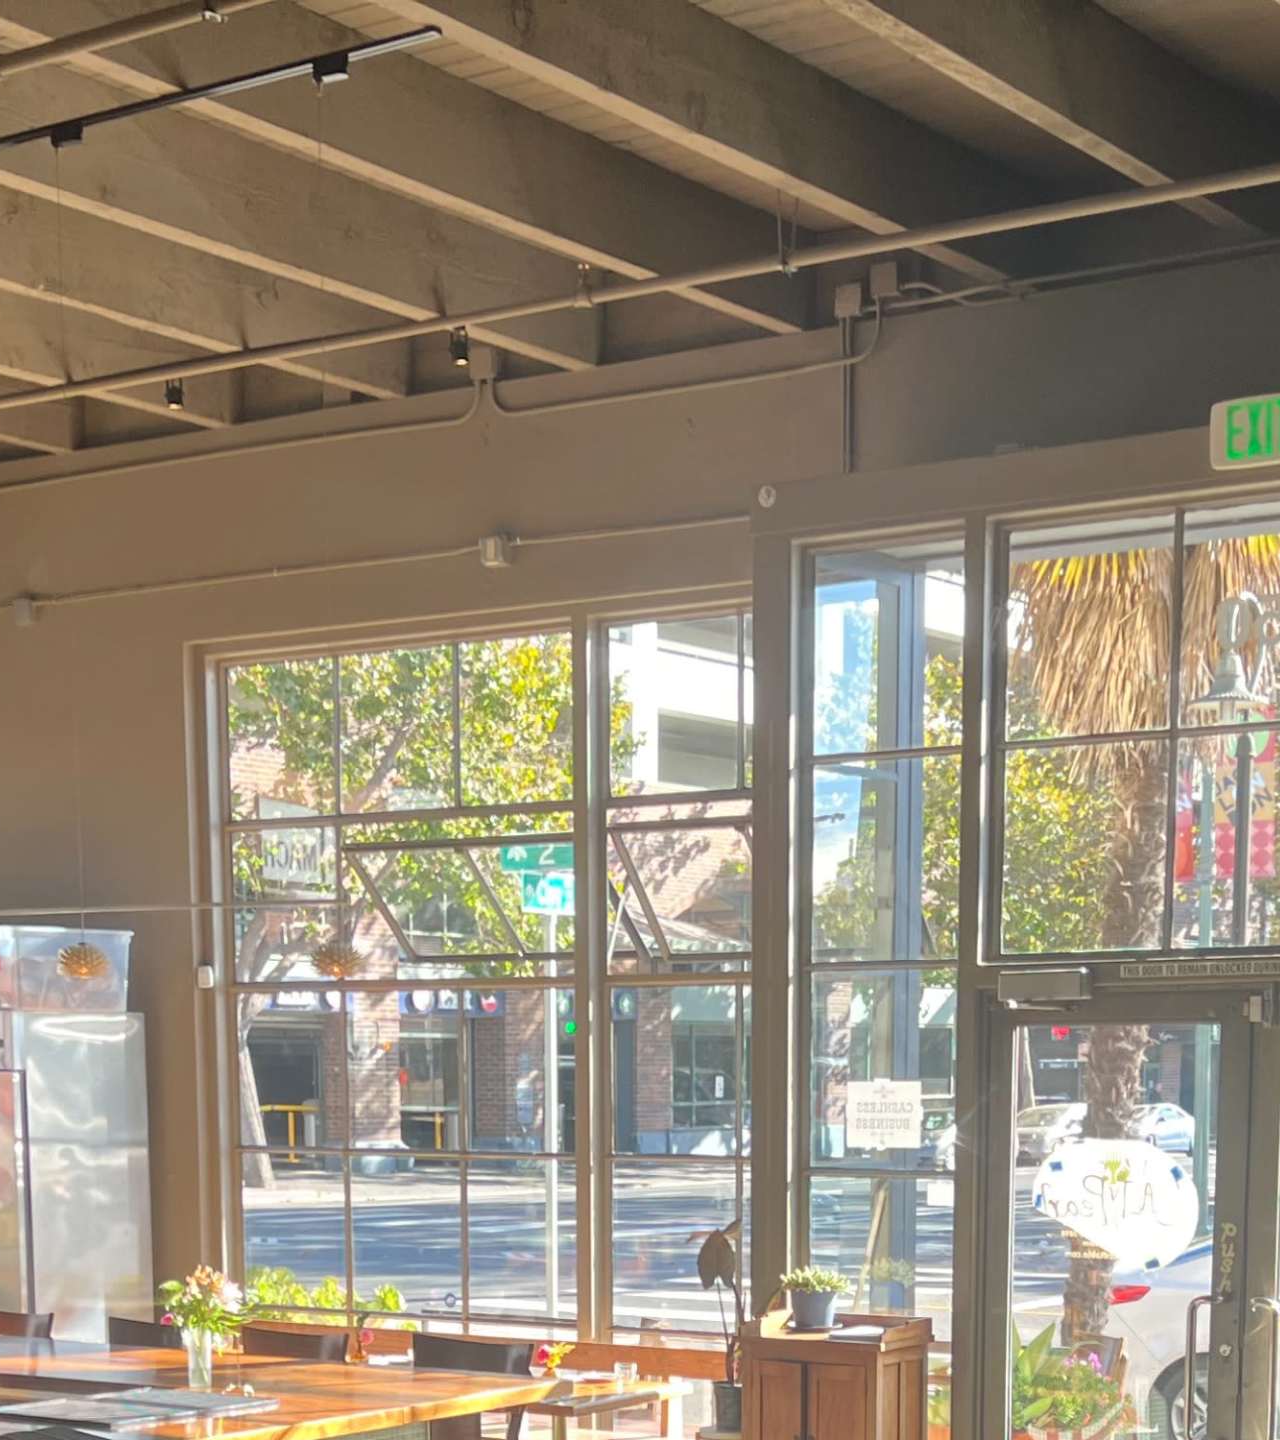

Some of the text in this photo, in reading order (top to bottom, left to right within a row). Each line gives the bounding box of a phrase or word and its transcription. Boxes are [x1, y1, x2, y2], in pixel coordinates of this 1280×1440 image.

[1122, 965, 1140, 977] THIS
[1142, 965, 1163, 976] DOOR
[1177, 963, 1207, 976] REMAIN
[1209, 962, 1252, 975] UNLOCKED
